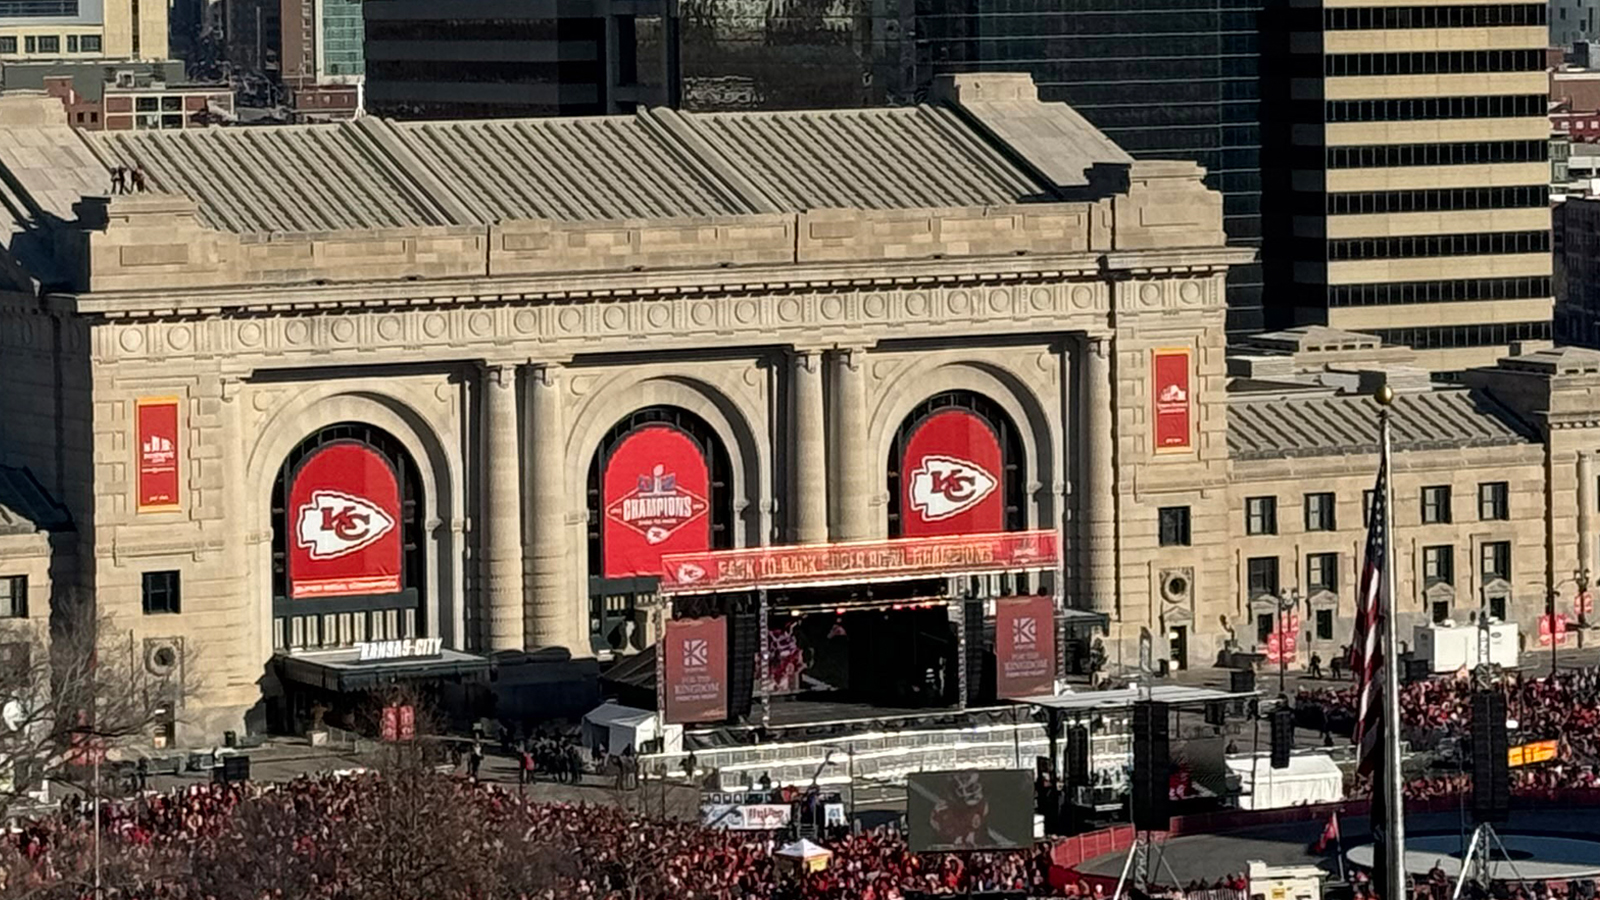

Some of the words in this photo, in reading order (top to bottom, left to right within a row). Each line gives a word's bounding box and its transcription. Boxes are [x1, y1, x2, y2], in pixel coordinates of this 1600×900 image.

[931, 469, 976, 503] KC
[623, 496, 692, 521] CHAMPIONS
[321, 506, 370, 541] KC
[360, 640, 412, 661] KANSAS
[415, 637, 443, 656] CITY
[674, 682, 720, 695] KINGDOM
